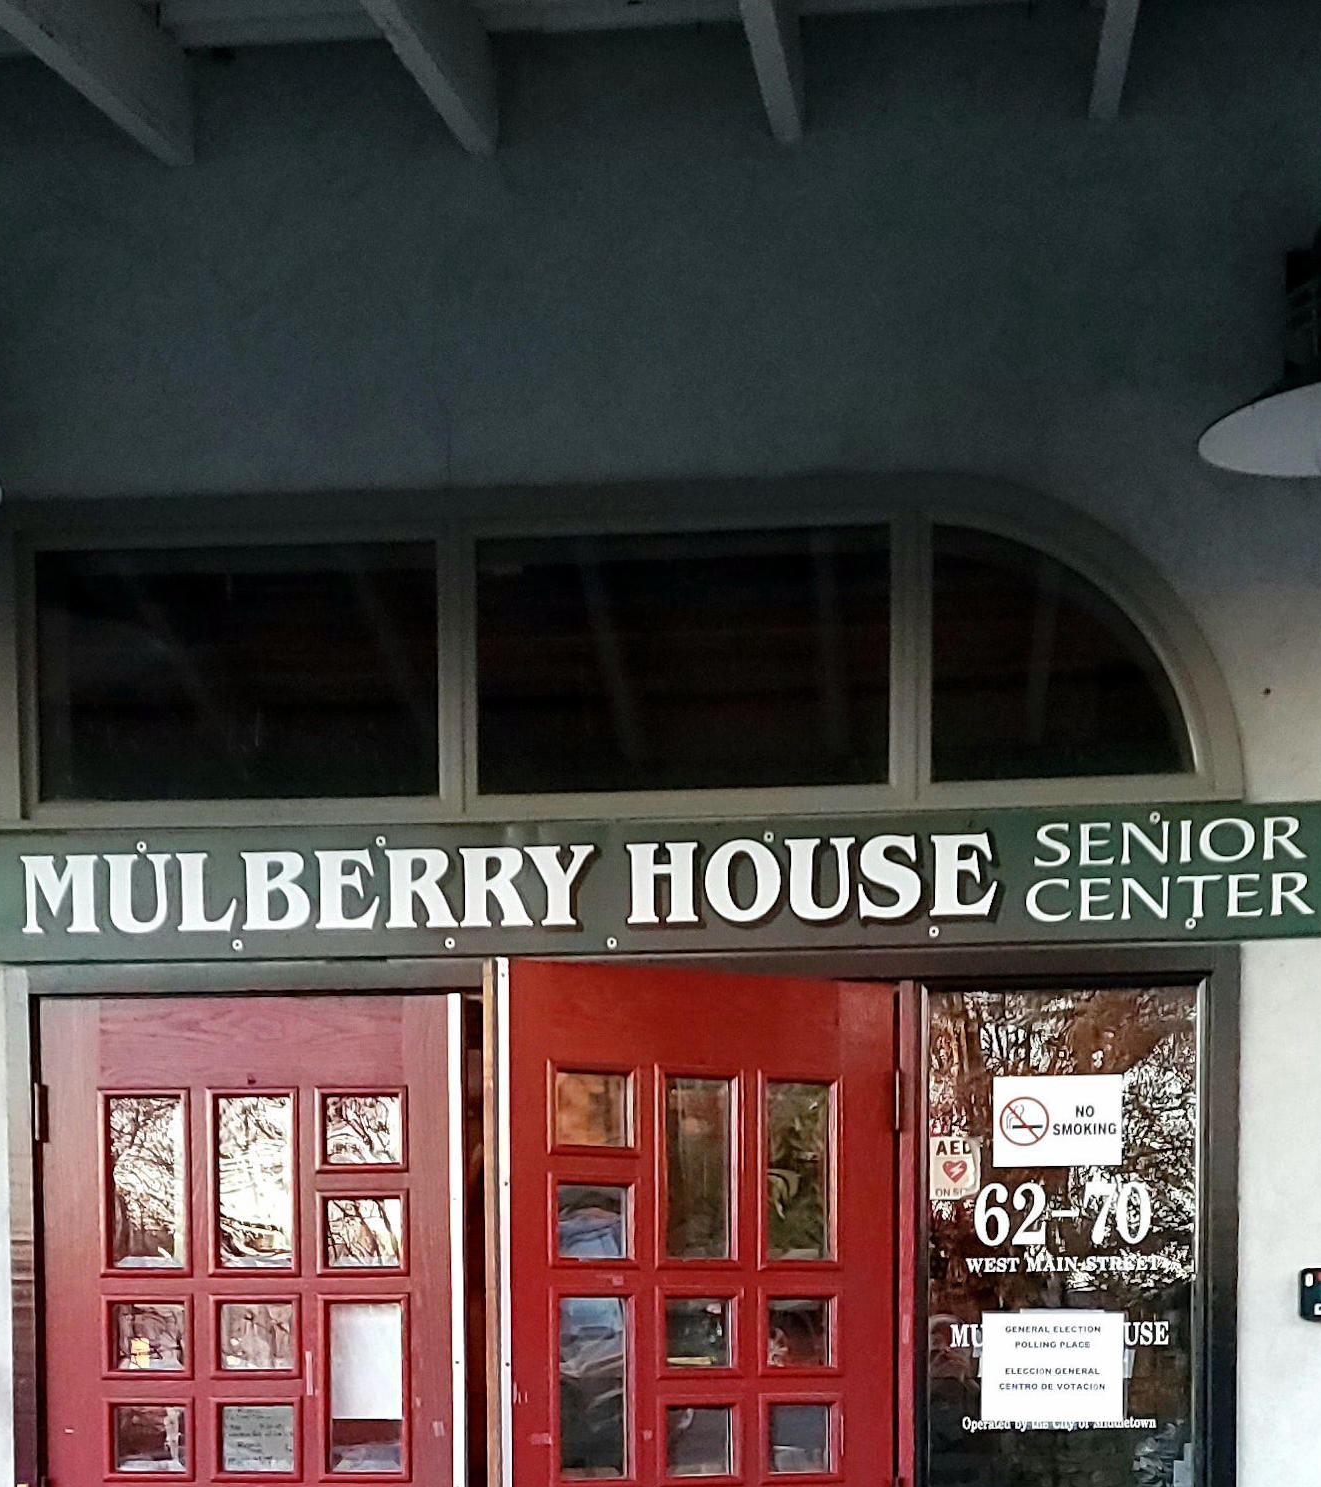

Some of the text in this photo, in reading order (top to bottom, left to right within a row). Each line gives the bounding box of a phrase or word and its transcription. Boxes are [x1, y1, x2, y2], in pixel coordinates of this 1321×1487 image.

[1034, 816, 1308, 868] SENIOR
[20, 831, 1000, 934] MULBERRY HOUSE
[1025, 871, 1316, 924] CENTER
[1075, 1104, 1095, 1118] NO
[1052, 1122, 1118, 1137] SMOKING
[935, 1140, 972, 1156] AED
[935, 1187, 951, 1198] ON
[974, 1181, 1152, 1247] 62-70
[966, 1255, 1160, 1273] WEST MAIN STREET
[1005, 1325, 1102, 1334] GENERAL ELECTION
[1122, 1320, 1170, 1346] USE
[1014, 1341, 1091, 1349] POLLING PLACE
[1055, 1367, 1100, 1376] GENERAL
[999, 1383, 1038, 1391] CENTRO
[1041, 1383, 1054, 1391] DE
